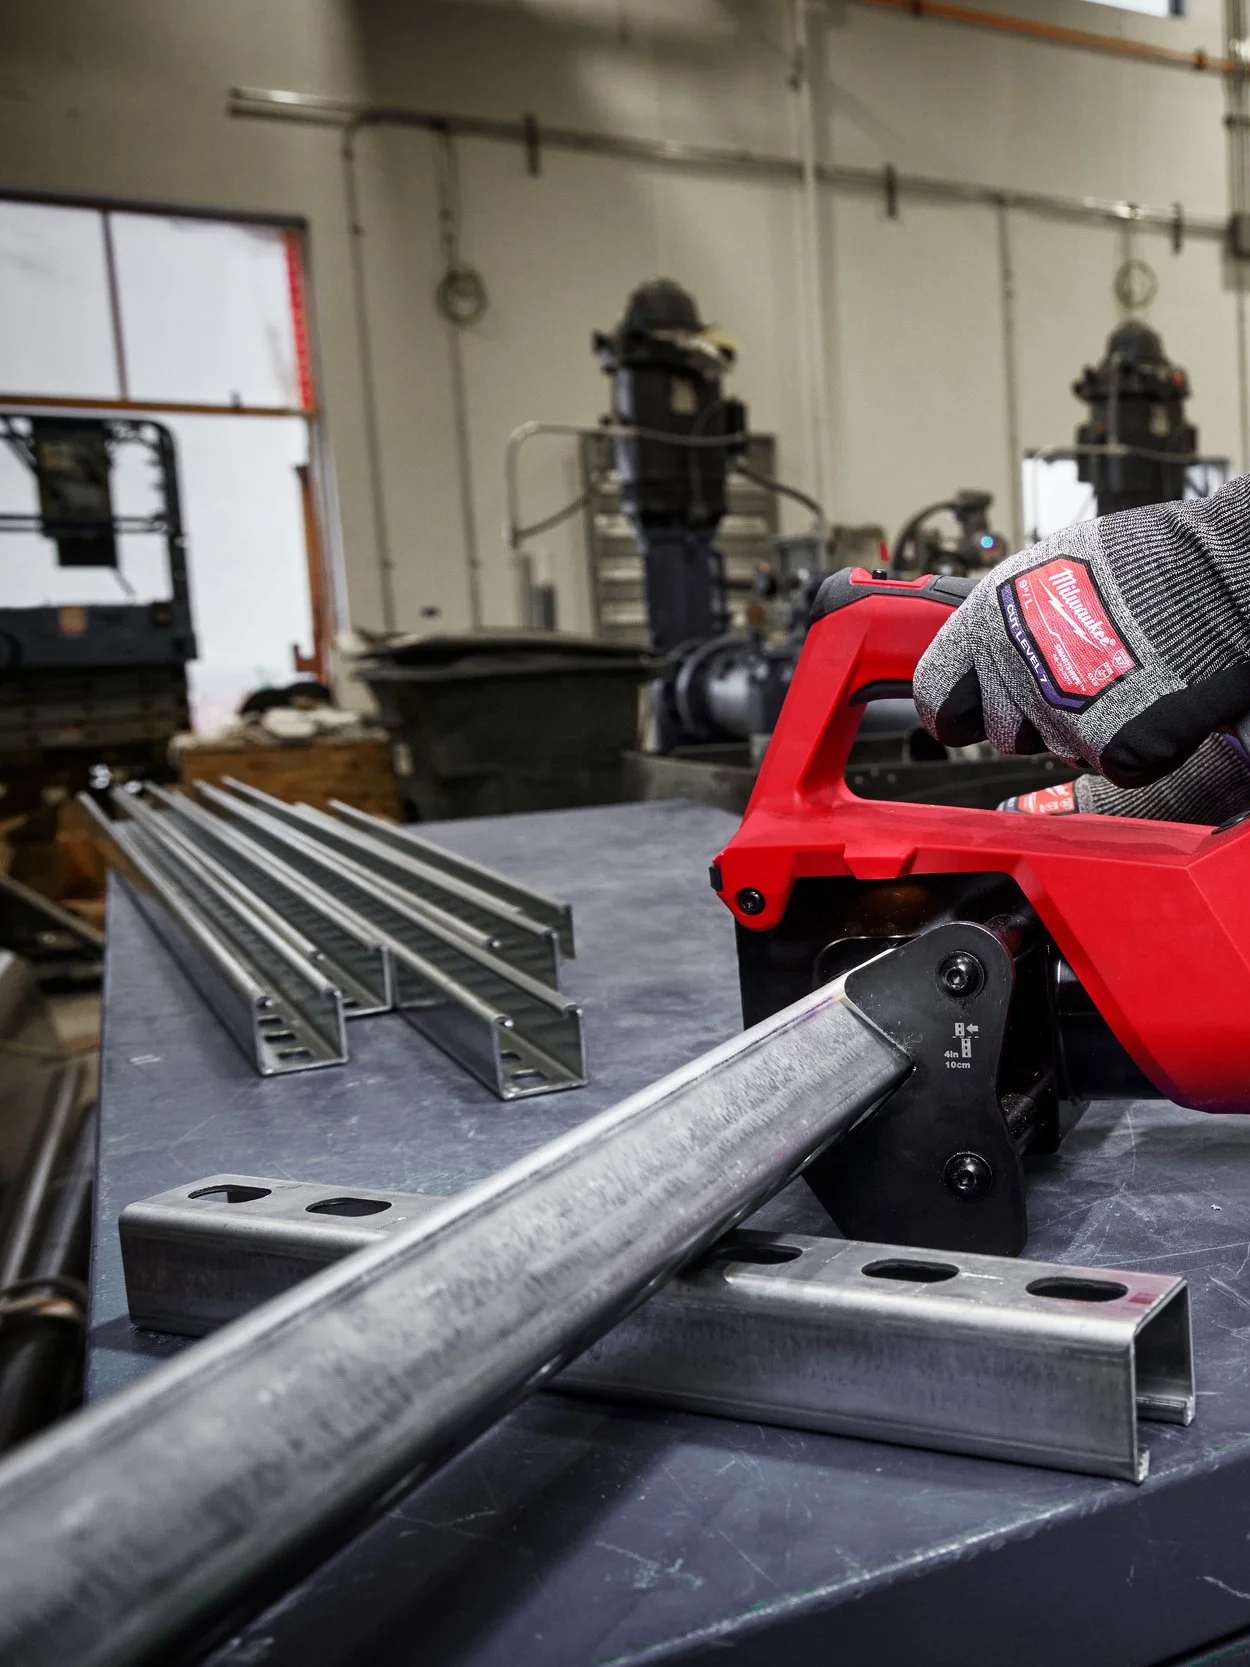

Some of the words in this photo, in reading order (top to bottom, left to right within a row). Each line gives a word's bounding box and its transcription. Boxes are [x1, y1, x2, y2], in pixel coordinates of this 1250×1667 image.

[1007, 604, 1020, 628] CUT
[1016, 631, 1041, 673] LEVEL
[1040, 674, 1047, 683] 7
[945, 1061, 971, 1069] 10cm
